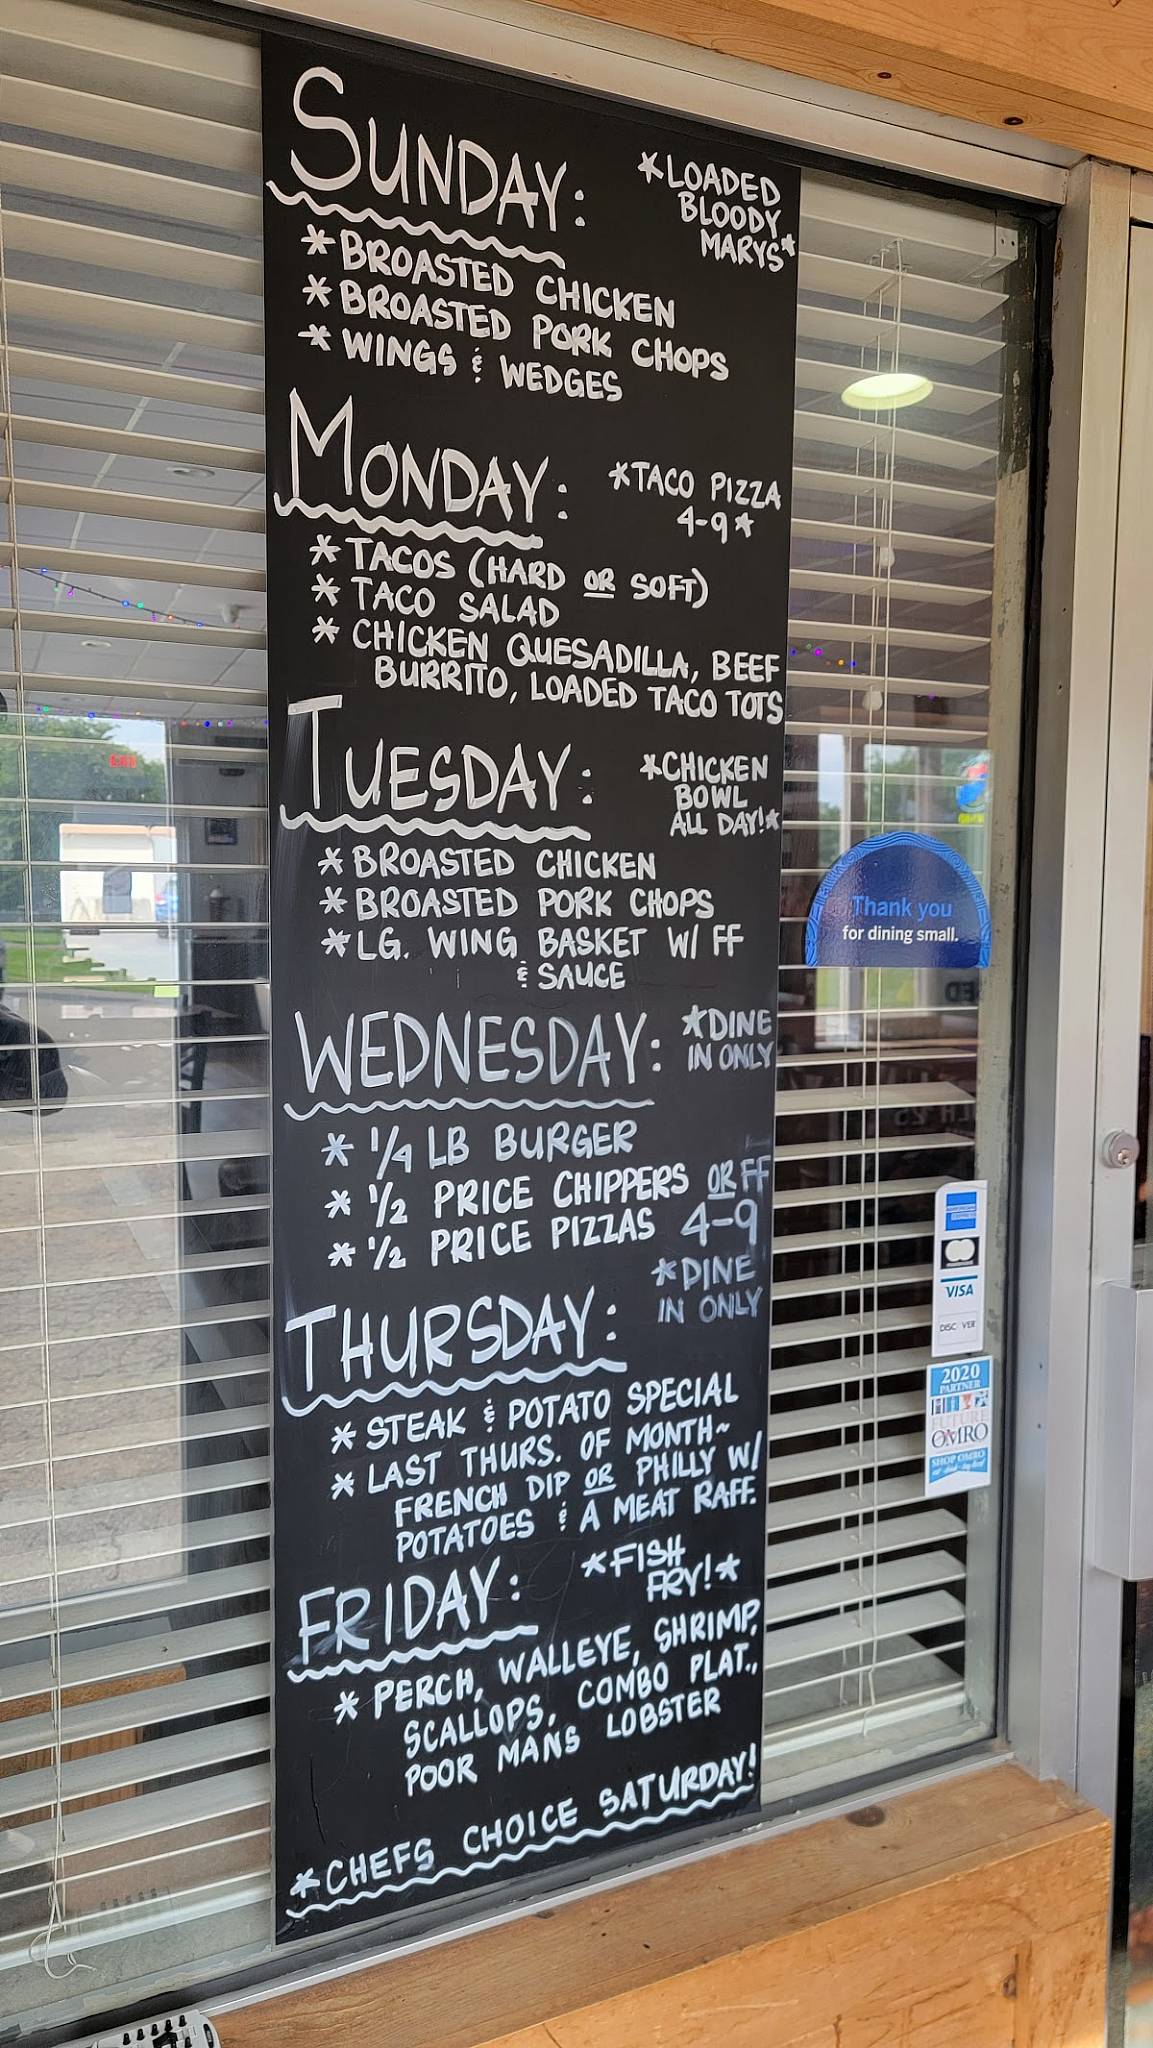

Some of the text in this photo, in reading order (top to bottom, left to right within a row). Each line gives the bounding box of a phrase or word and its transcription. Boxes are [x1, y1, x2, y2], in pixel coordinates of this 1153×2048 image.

[290, 66, 586, 232] SUNDAY:
[666, 154, 781, 207] LOADED
[677, 190, 782, 240] BLOODY
[700, 228, 785, 273] MARYS
[339, 228, 675, 329] BROASTED CHICKEN
[339, 279, 729, 381] BROASTED PORK CHOPS
[341, 327, 457, 377] WINGS
[499, 354, 623, 402] WEDGES
[290, 387, 568, 524] MONDAY:
[630, 461, 782, 511] TACO PIZZA
[344, 536, 709, 609] TACOS (HARD OR SOFT)
[350, 576, 560, 628] TACO SALAD
[352, 618, 781, 685] CHICKEN QUESADILLA, BEEF
[374, 655, 784, 725] BURRITO, LOADED TACO TOTS
[287, 691, 593, 814] TUESDAY:
[661, 750, 769, 785] CHICKEN
[670, 809, 708, 836] ALL
[675, 784, 748, 810] BOWL
[351, 841, 657, 881] BROASTED CHICKEN
[355, 885, 715, 922] BROASTED PORK CHOPS
[852, 895, 953, 922] Thank you
[357, 923, 745, 961] LG. WING BASKET W/ FF
[842, 925, 959, 943] for dining small.
[537, 960, 626, 991] SAUCE
[707, 1007, 772, 1042] DINE
[294, 1010, 662, 1096] WEDNESDAY:
[687, 1041, 774, 1072] IN ONLY
[427, 1125, 470, 1170] LB
[494, 1119, 638, 1163] BURGER
[433, 1175, 534, 1219] PRICE
[552, 1162, 690, 1209] CHIPPERS
[708, 1164, 735, 1193] OR
[740, 1154, 772, 1193] FF
[430, 1219, 533, 1267] PRICE
[550, 1206, 656, 1251] PIZZAS
[680, 1198, 758, 1248] 4-9
[680, 1254, 756, 1292] DINE
[945, 1284, 974, 1298] VISA
[657, 1286, 763, 1324] IN ONLY
[284, 1285, 617, 1392] THURSDAY:
[940, 1379, 981, 1394] PARTNER
[942, 1363, 981, 1384] 2020
[365, 1406, 467, 1451] STEAK
[508, 1388, 611, 1431] POTATO
[626, 1371, 740, 1416] SPECIAL
[367, 1450, 443, 1495] LAST
[461, 1435, 562, 1478] THURS.
[579, 1426, 612, 1462] OF
[394, 1430, 763, 1529] FRENCH DIP OR PHILLY W/
[395, 1508, 535, 1564] POTATOES
[579, 1498, 601, 1534] A
[613, 1487, 681, 1525] MEAT
[609, 1535, 685, 1578] FISH
[298, 1555, 521, 1666] FRIDAY:
[374, 1667, 484, 1720] PERCH,
[497, 1624, 640, 1685] WALLEYE,
[403, 1693, 562, 1763] SCALLOPS,
[577, 1661, 669, 1710] COMBO
[404, 1686, 722, 1797] POOR MANS LOBSTER
[326, 1742, 757, 1896] CHEFS CHOICE SATURDAY!
